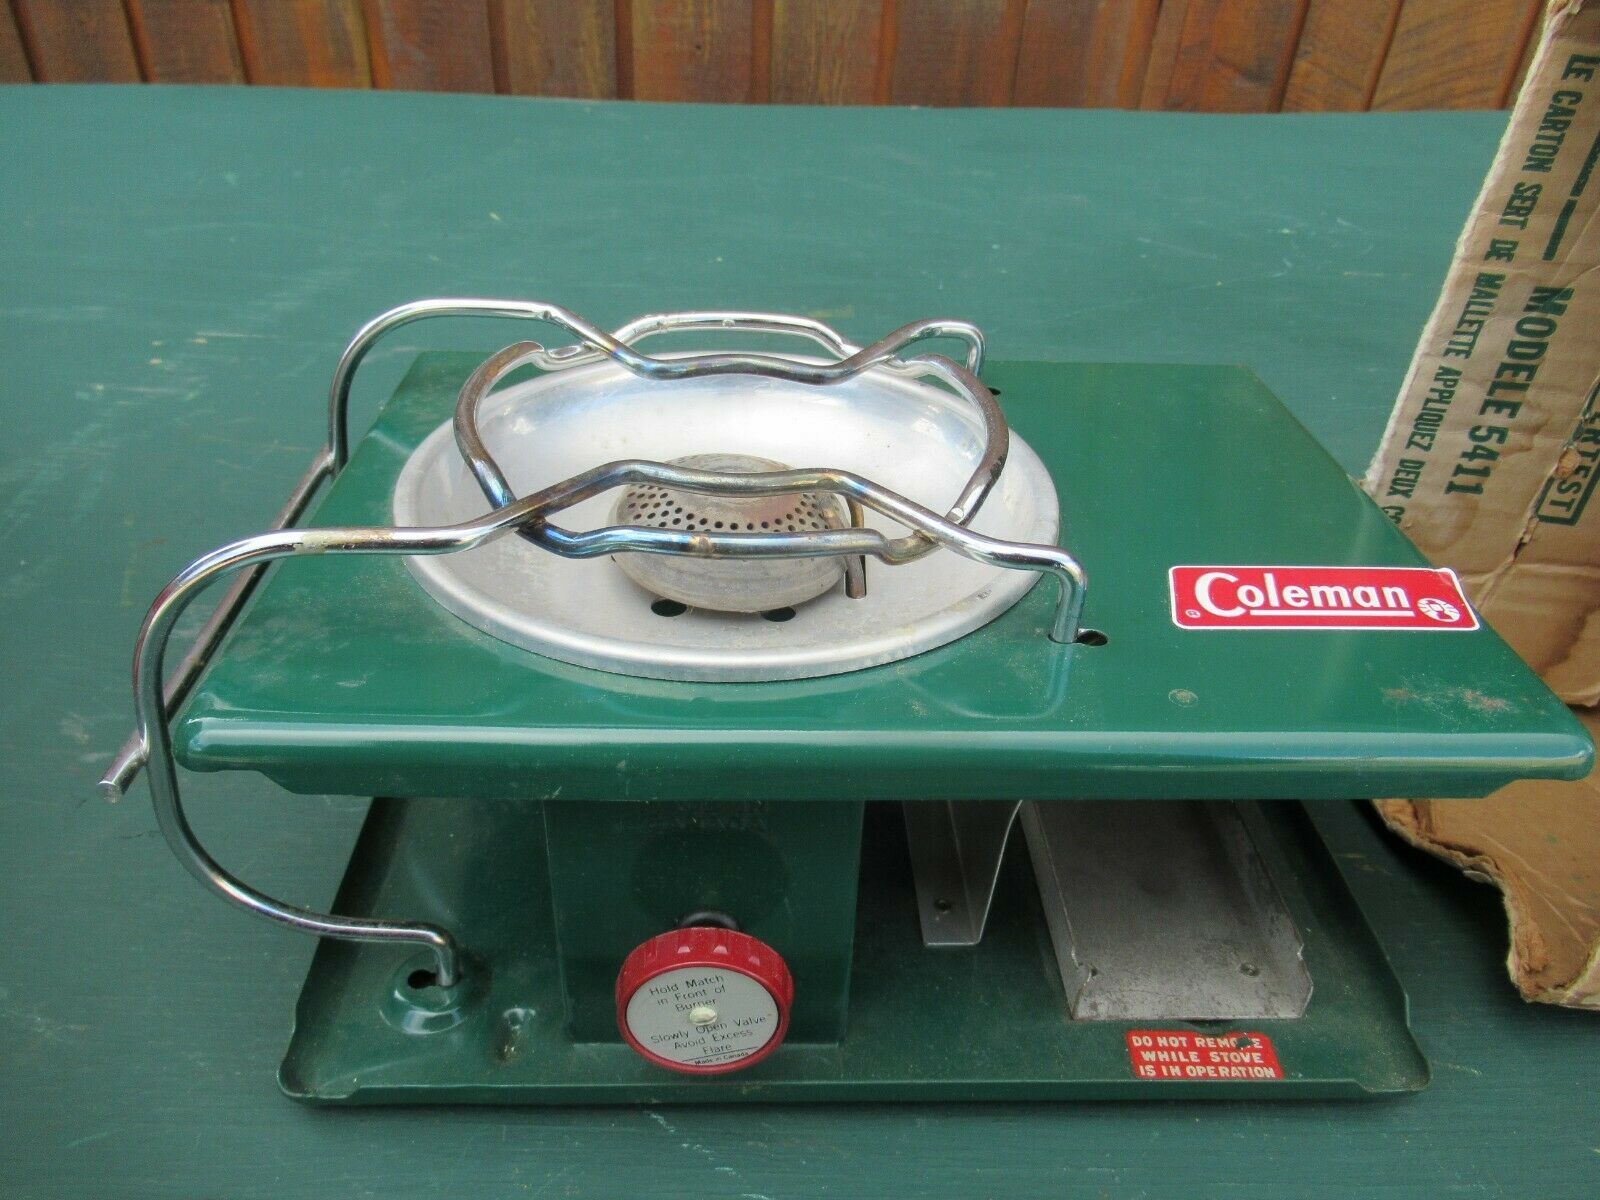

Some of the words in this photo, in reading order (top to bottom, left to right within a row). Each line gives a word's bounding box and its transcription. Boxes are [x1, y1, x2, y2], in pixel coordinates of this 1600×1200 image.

[1561, 54, 1600, 82] LE
[1521, 90, 1583, 173] CARTON
[1498, 182, 1543, 230] SERT
[1483, 238, 1519, 263] DE
[1443, 272, 1506, 360] MALLETTE
[1479, 285, 1575, 419] MODELE
[1405, 364, 1463, 452] APPLIQUEZ
[1444, 425, 1509, 495] 5411
[1386, 458, 1426, 499] DEUX
[1195, 572, 1410, 617] Coleman
[649, 983, 679, 996] Hold
[685, 974, 725, 989] Match
[657, 996, 669, 1006] in
[675, 989, 708, 1002] Front
[714, 984, 726, 995] of
[675, 998, 717, 1012] Burner
[650, 1029, 689, 1044] Slowly
[696, 1022, 728, 1036] Open
[734, 1015, 766, 1028] Valve
[674, 1036, 706, 1050] Avoid
[712, 1029, 753, 1043] Excess
[1132, 1035, 1153, 1048] DO
[1156, 1036, 1188, 1048] NOT
[1194, 1036, 1264, 1049] REMOE
[702, 1043, 732, 1055] Flare
[1140, 1050, 1201, 1063] WHILE
[1209, 1051, 1264, 1064] STOVE
[1138, 1064, 1156, 1077] IS
[1161, 1065, 1182, 1077] IN
[1185, 1065, 1276, 1078] OPERATION
